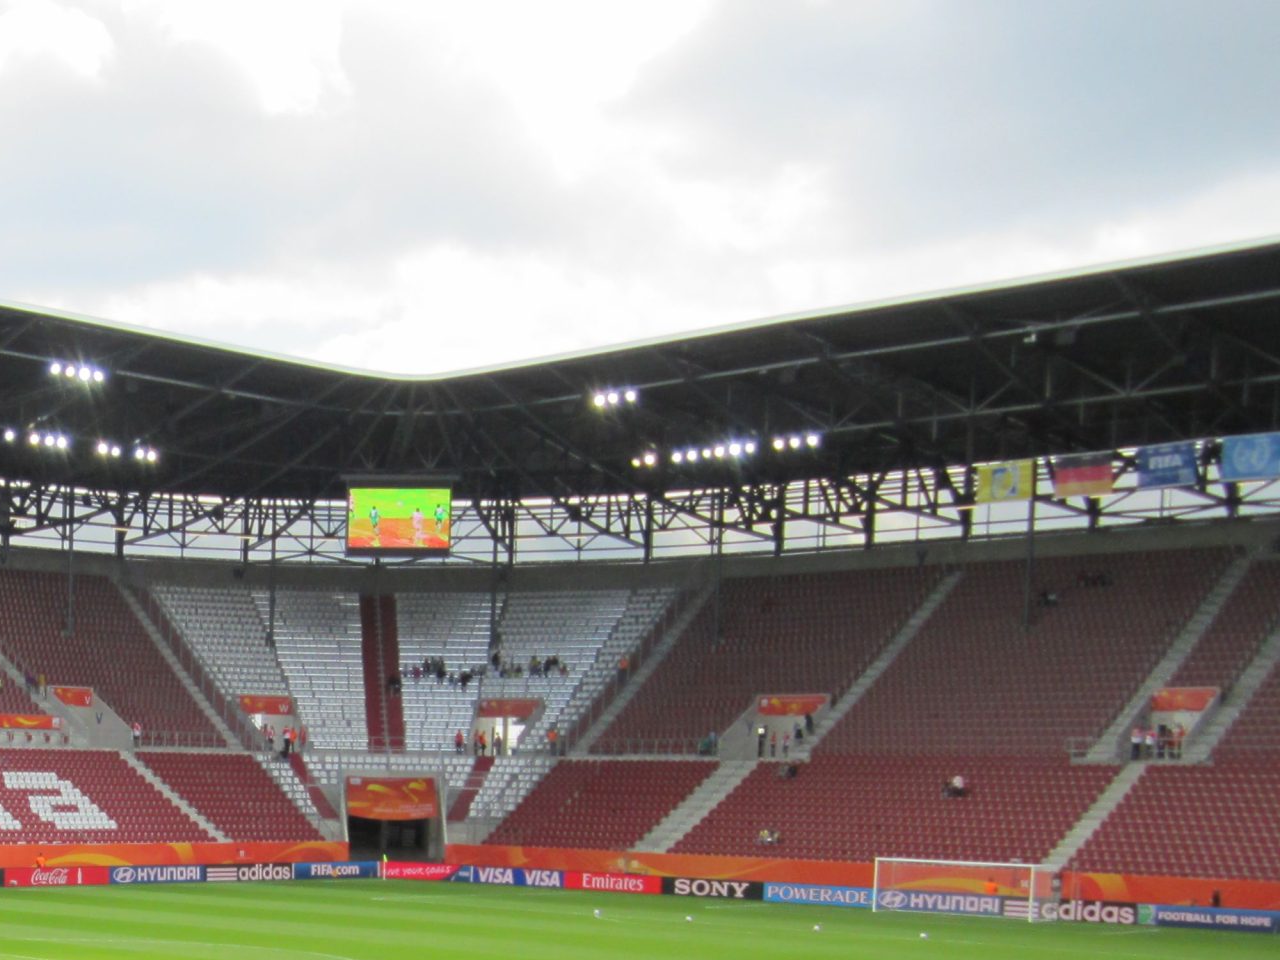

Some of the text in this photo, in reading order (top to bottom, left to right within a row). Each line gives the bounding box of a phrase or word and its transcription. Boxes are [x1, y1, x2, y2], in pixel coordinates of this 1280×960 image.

[84, 696, 91, 705] V
[278, 703, 289, 713] W
[137, 866, 200, 882] HYUNDAI
[239, 863, 291, 881] adidas
[478, 867, 515, 885] VISA
[524, 869, 561, 888] VISA
[581, 873, 644, 892] Emirates
[673, 878, 749, 898] SONY
[767, 885, 869, 905] POWERADE
[910, 893, 1000, 913] HYUNDAI
[1041, 901, 1135, 924] adidas
[1158, 911, 1271, 928] FOOTBALL FOR HOPE
